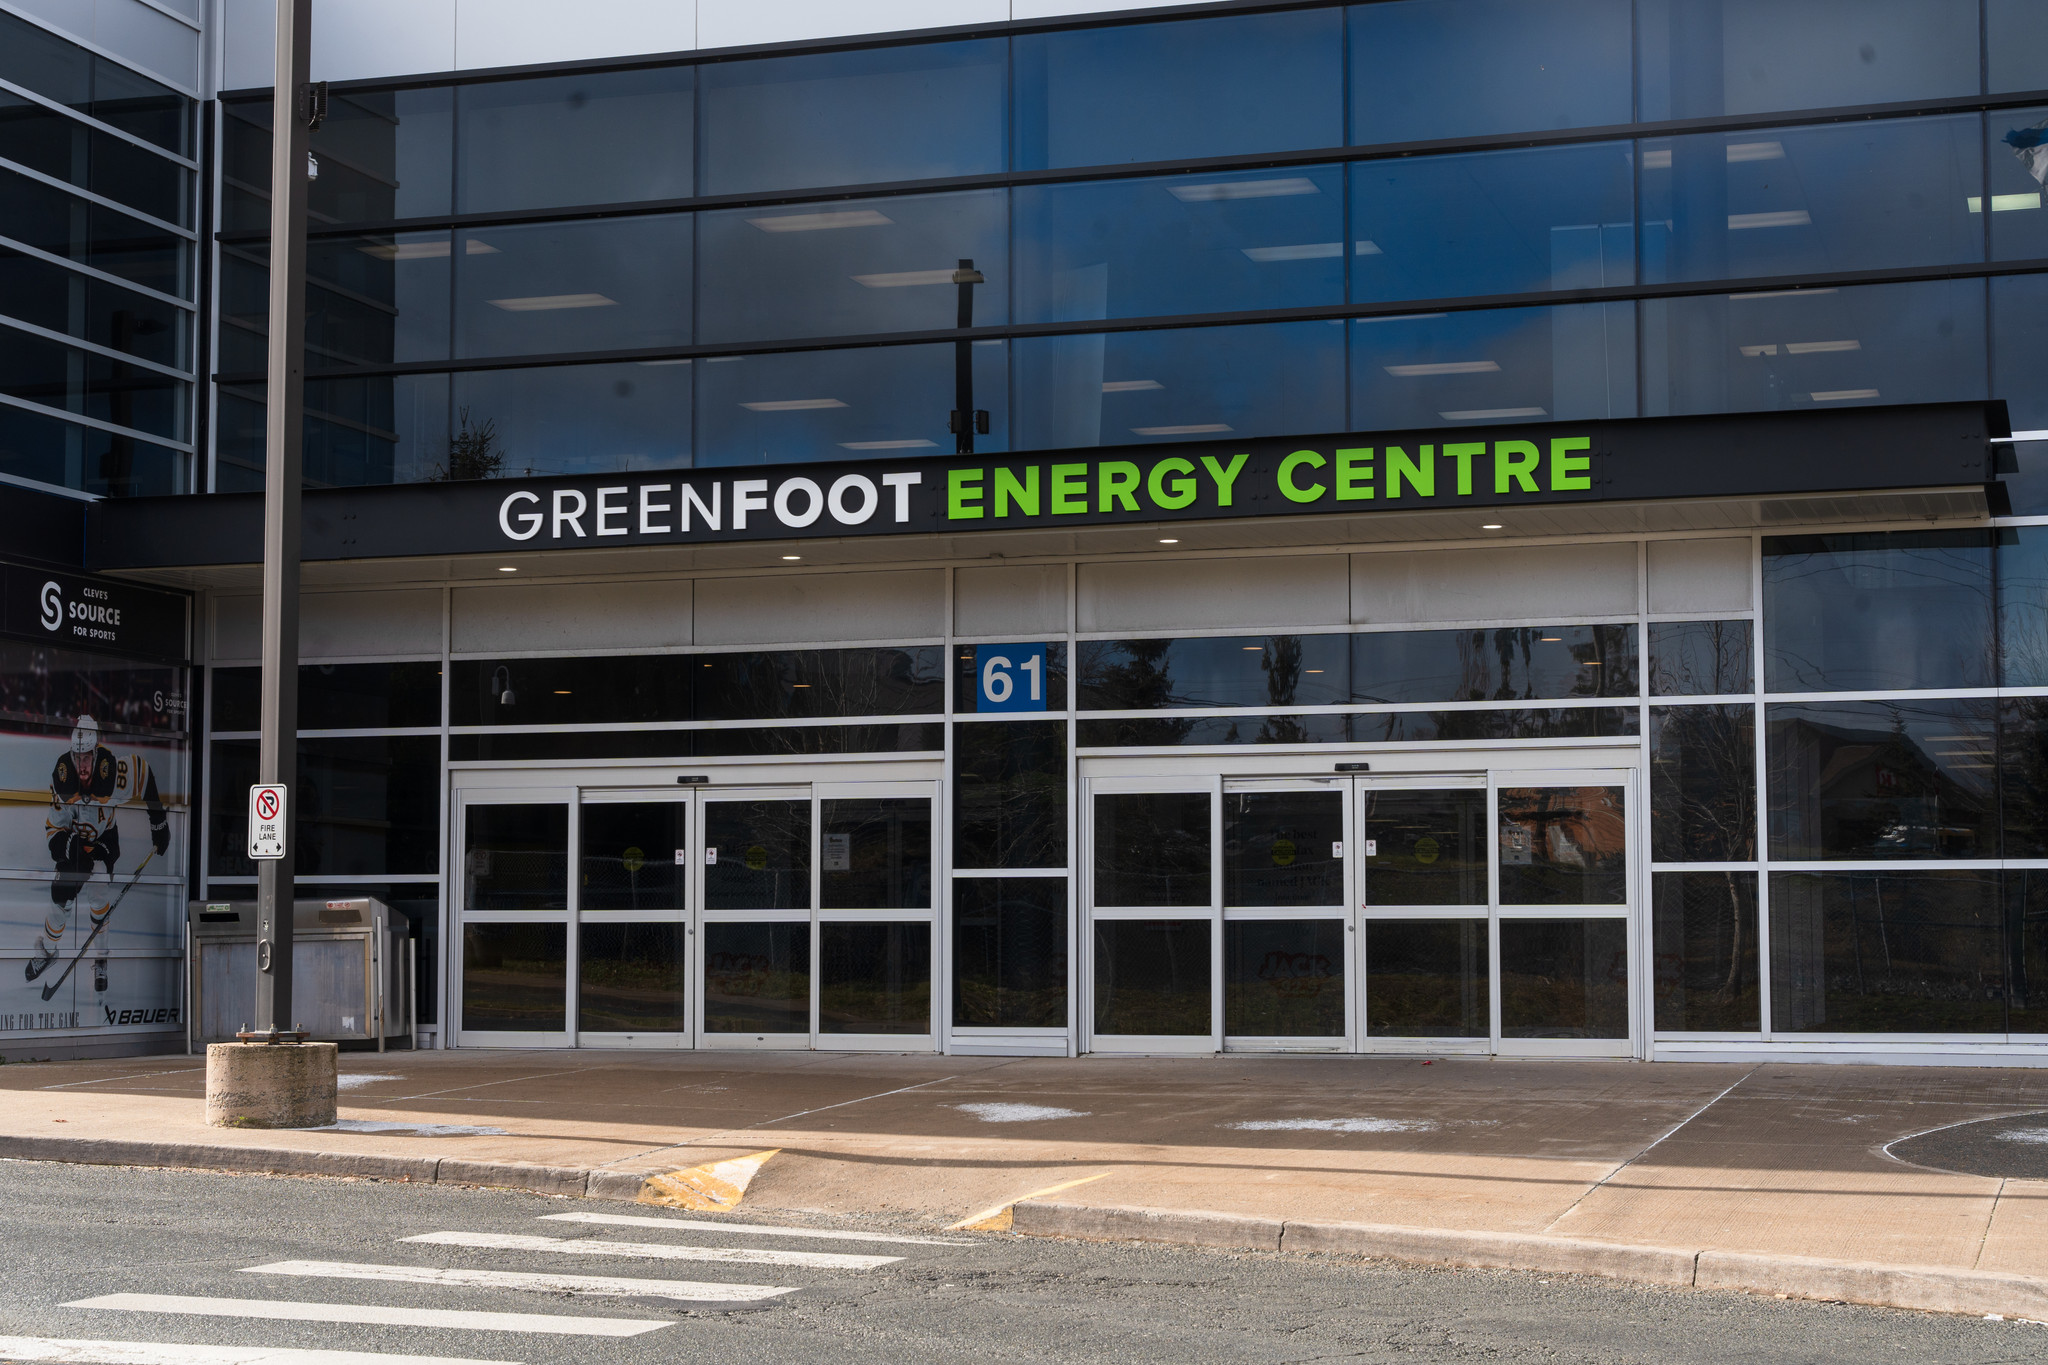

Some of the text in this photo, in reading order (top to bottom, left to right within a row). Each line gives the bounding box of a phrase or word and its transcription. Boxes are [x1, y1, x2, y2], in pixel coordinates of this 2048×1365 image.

[500, 436, 1592, 541] GREENFOOT ENERGY CENTRE
[83, 587, 109, 600] CLEVE'S
[69, 601, 121, 626] SOURCE
[73, 625, 116, 641] FOR SPORTS
[983, 655, 1042, 702] 61
[165, 698, 187, 709] SOURCE
[260, 824, 276, 832] FIRE
[258, 832, 276, 841] LANE
[0, 1012, 80, 1031] ING FOR THE GAME
[117, 1008, 180, 1025] BAUER
